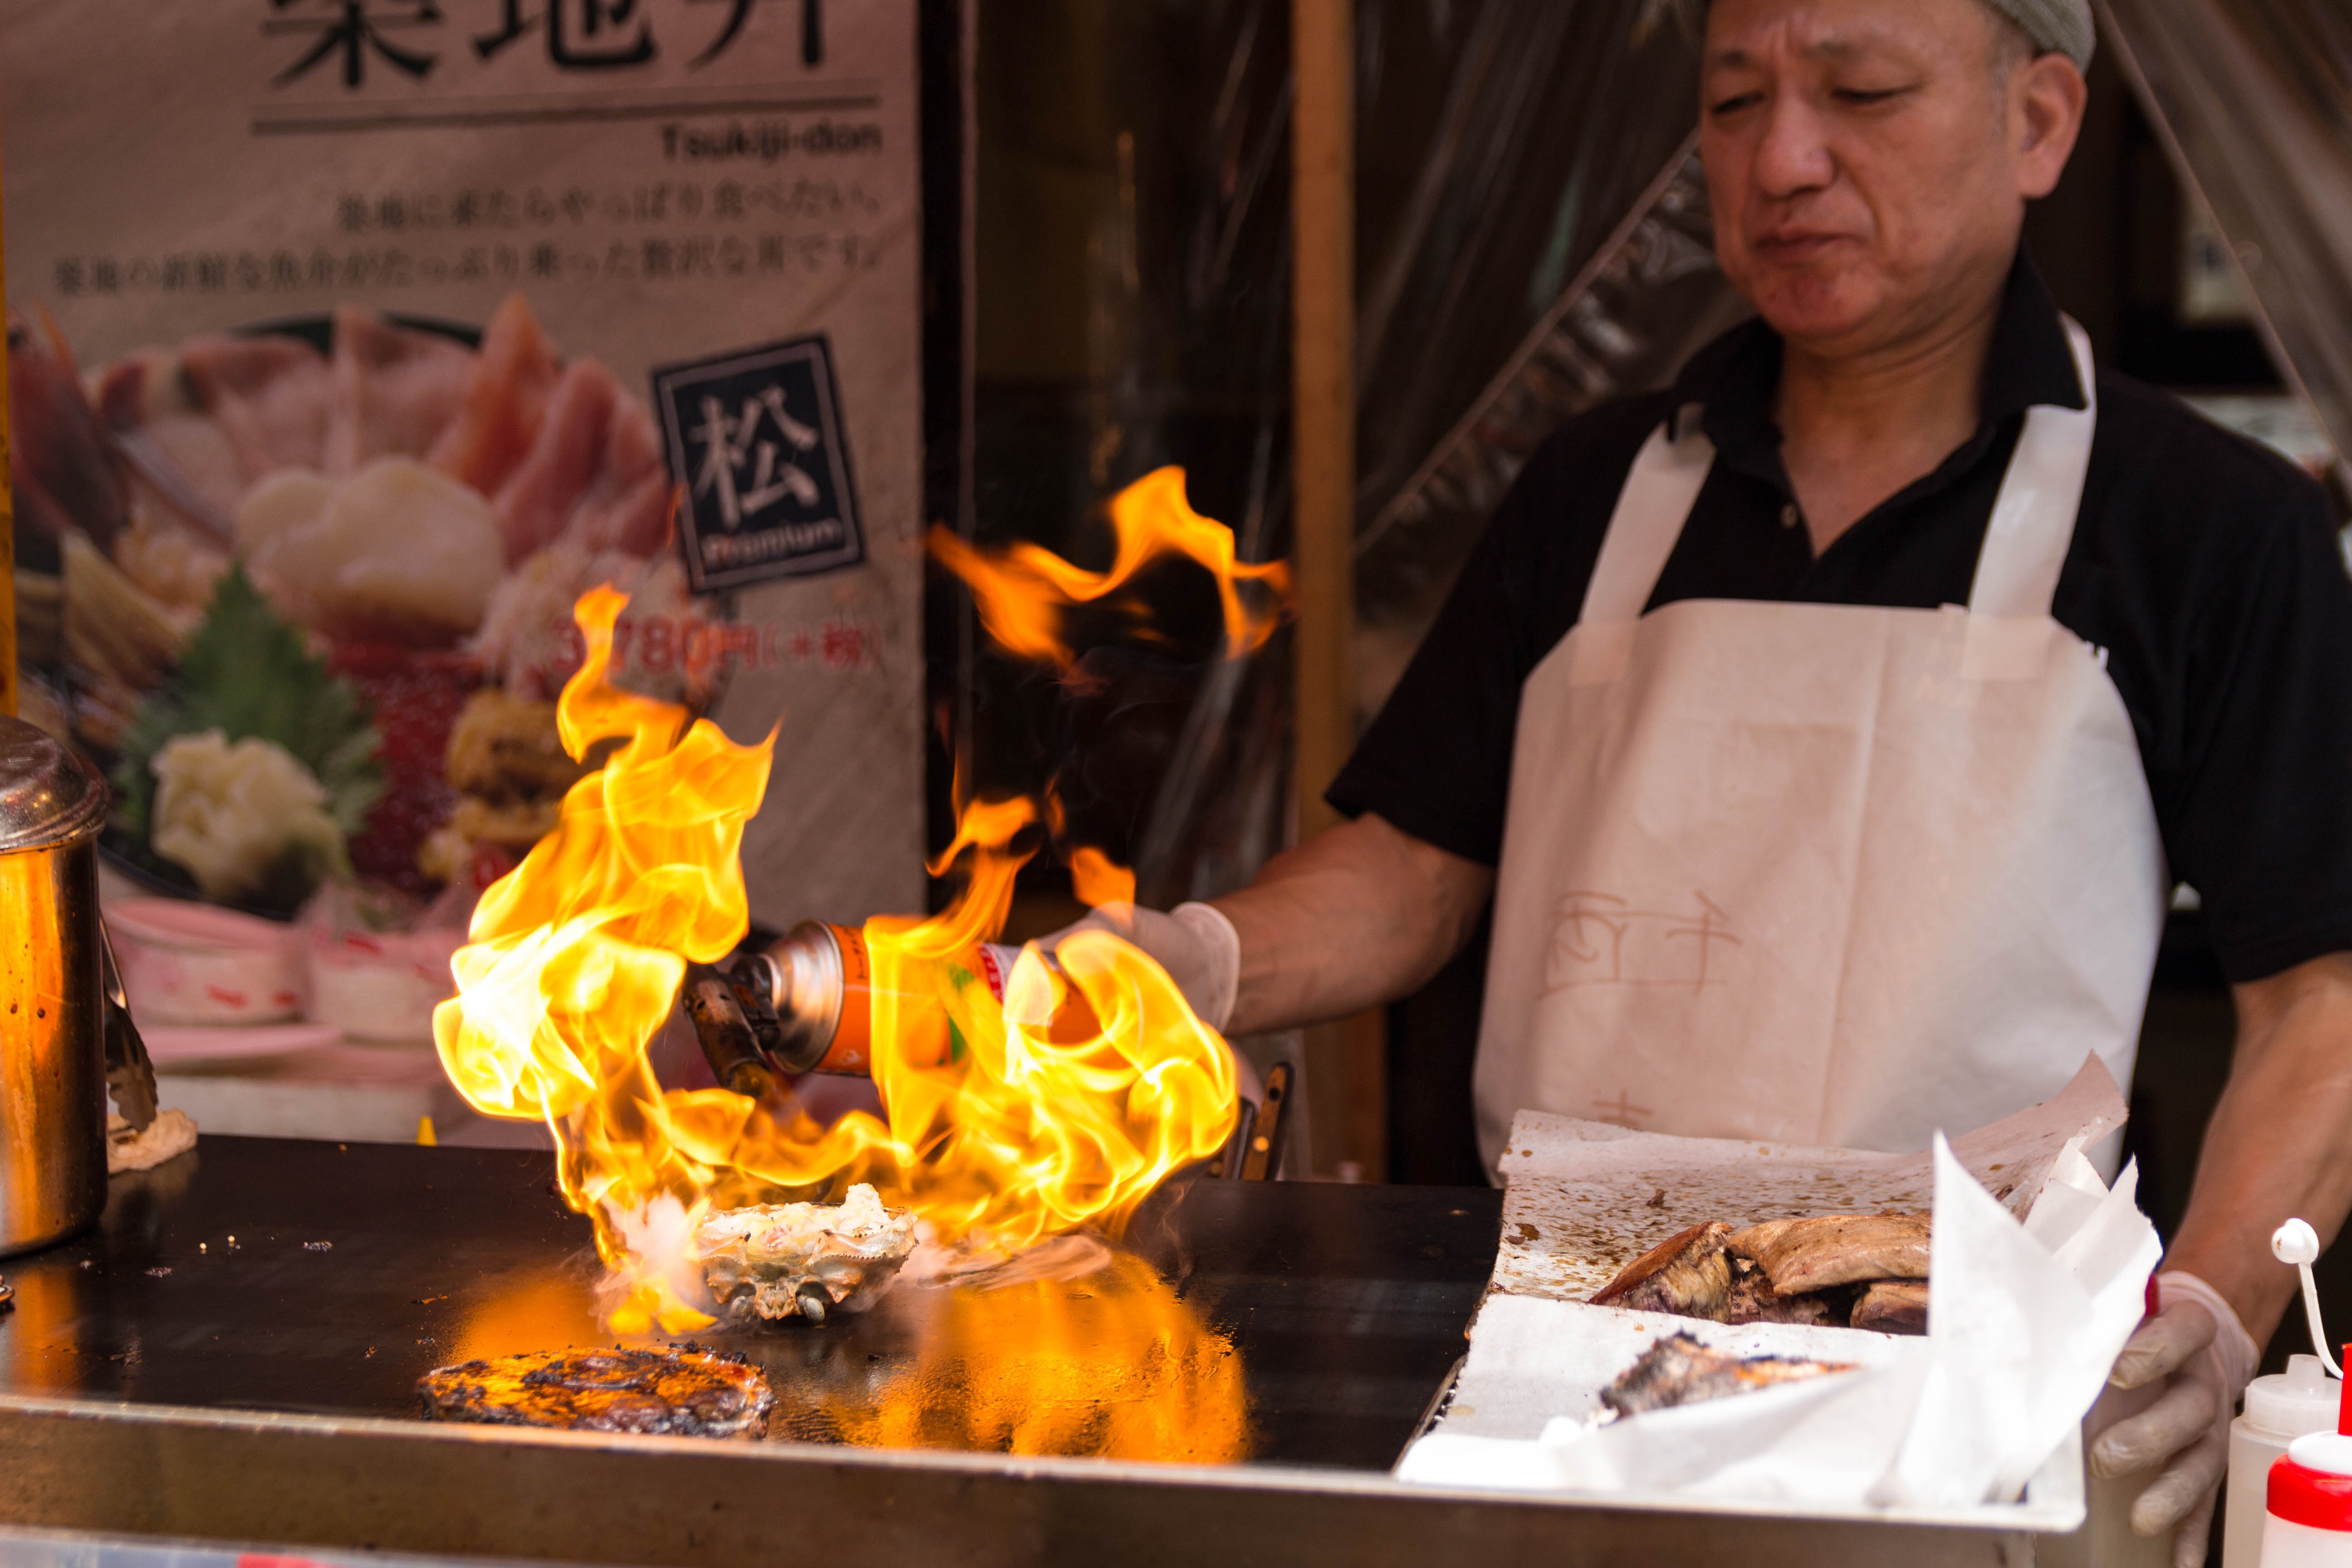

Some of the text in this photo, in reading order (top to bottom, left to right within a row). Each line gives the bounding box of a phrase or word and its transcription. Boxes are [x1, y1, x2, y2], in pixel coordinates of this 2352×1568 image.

[662, 120, 883, 164] Tsukiji-don
[688, 385, 819, 530] 松
[702, 517, 843, 567] Premium
